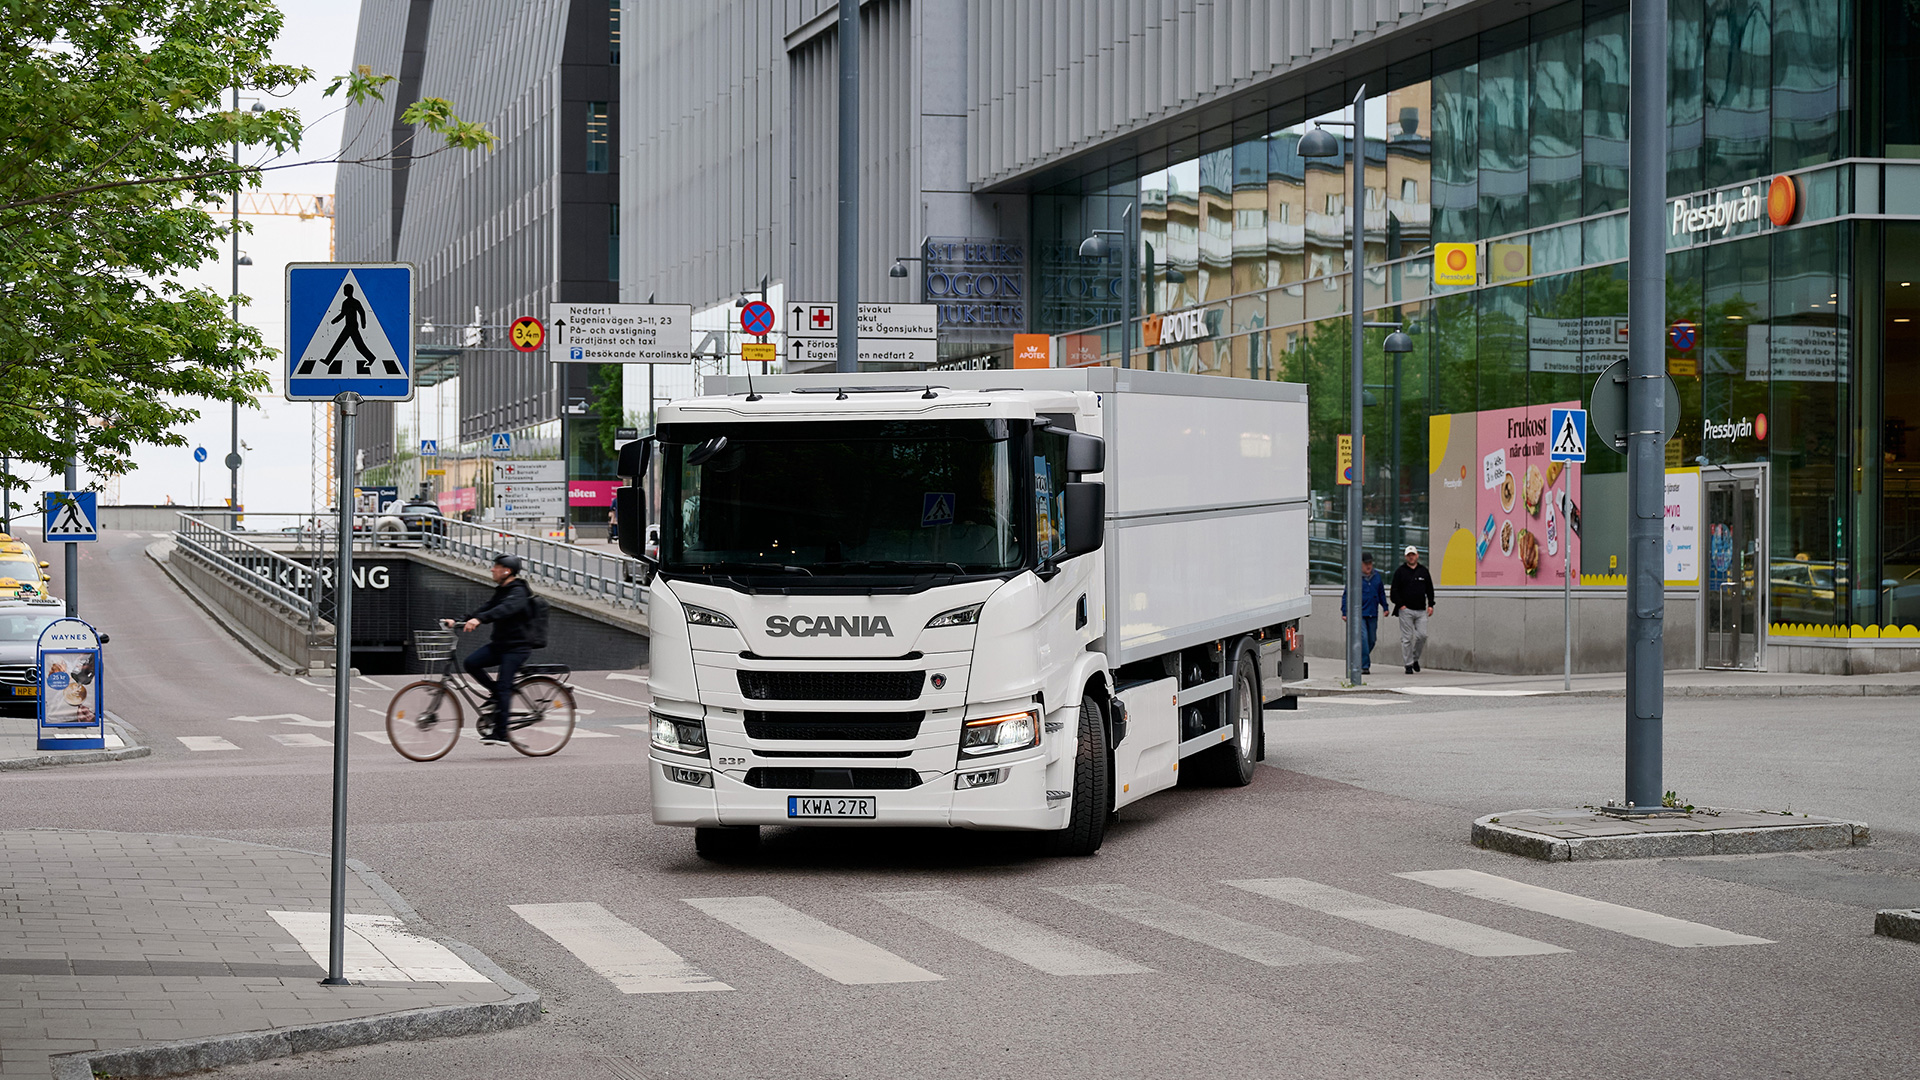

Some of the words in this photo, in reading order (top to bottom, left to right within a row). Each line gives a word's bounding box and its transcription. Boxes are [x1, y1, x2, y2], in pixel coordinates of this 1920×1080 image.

[1673, 186, 1760, 236] Pressbyrån
[964, 243, 1024, 262] ERIKS
[926, 268, 1022, 297] ÖGON
[1440, 273, 1474, 281] Pressbyrån
[569, 307, 605, 315] Nedfart
[607, 307, 612, 315] 1
[858, 306, 892, 314] sivakut
[937, 304, 1024, 327] JUKHUS
[569, 316, 634, 326] Eugeniavägen
[660, 316, 673, 325] 23
[1160, 307, 1210, 345] APOTEK
[569, 325, 587, 334] På-
[589, 326, 606, 334] och
[609, 326, 657, 336] avstigning
[876, 323, 934, 334] Ögonsjukhus
[569, 336, 617, 346] Färdtjänst
[619, 337, 636, 345] och
[638, 337, 656, 345] taxi
[807, 340, 838, 348] Förlos
[585, 349, 636, 358] Besökande
[639, 350, 689, 358] Karolinska
[873, 352, 906, 360] nedfart
[908, 351, 915, 360] 2
[1507, 416, 1547, 439] Frukost
[1703, 416, 1752, 443] Pressbyrån
[1509, 444, 1521, 458] när
[1522, 443, 1532, 458] du
[1532, 442, 1545, 456] vill!
[765, 615, 894, 637] SCANIA
[51, 633, 87, 641] WAYNES
[17, 686, 33, 695] HPE
[718, 757, 746, 765] 23P
[802, 799, 833, 815] KWA
[837, 799, 868, 815] 27R
